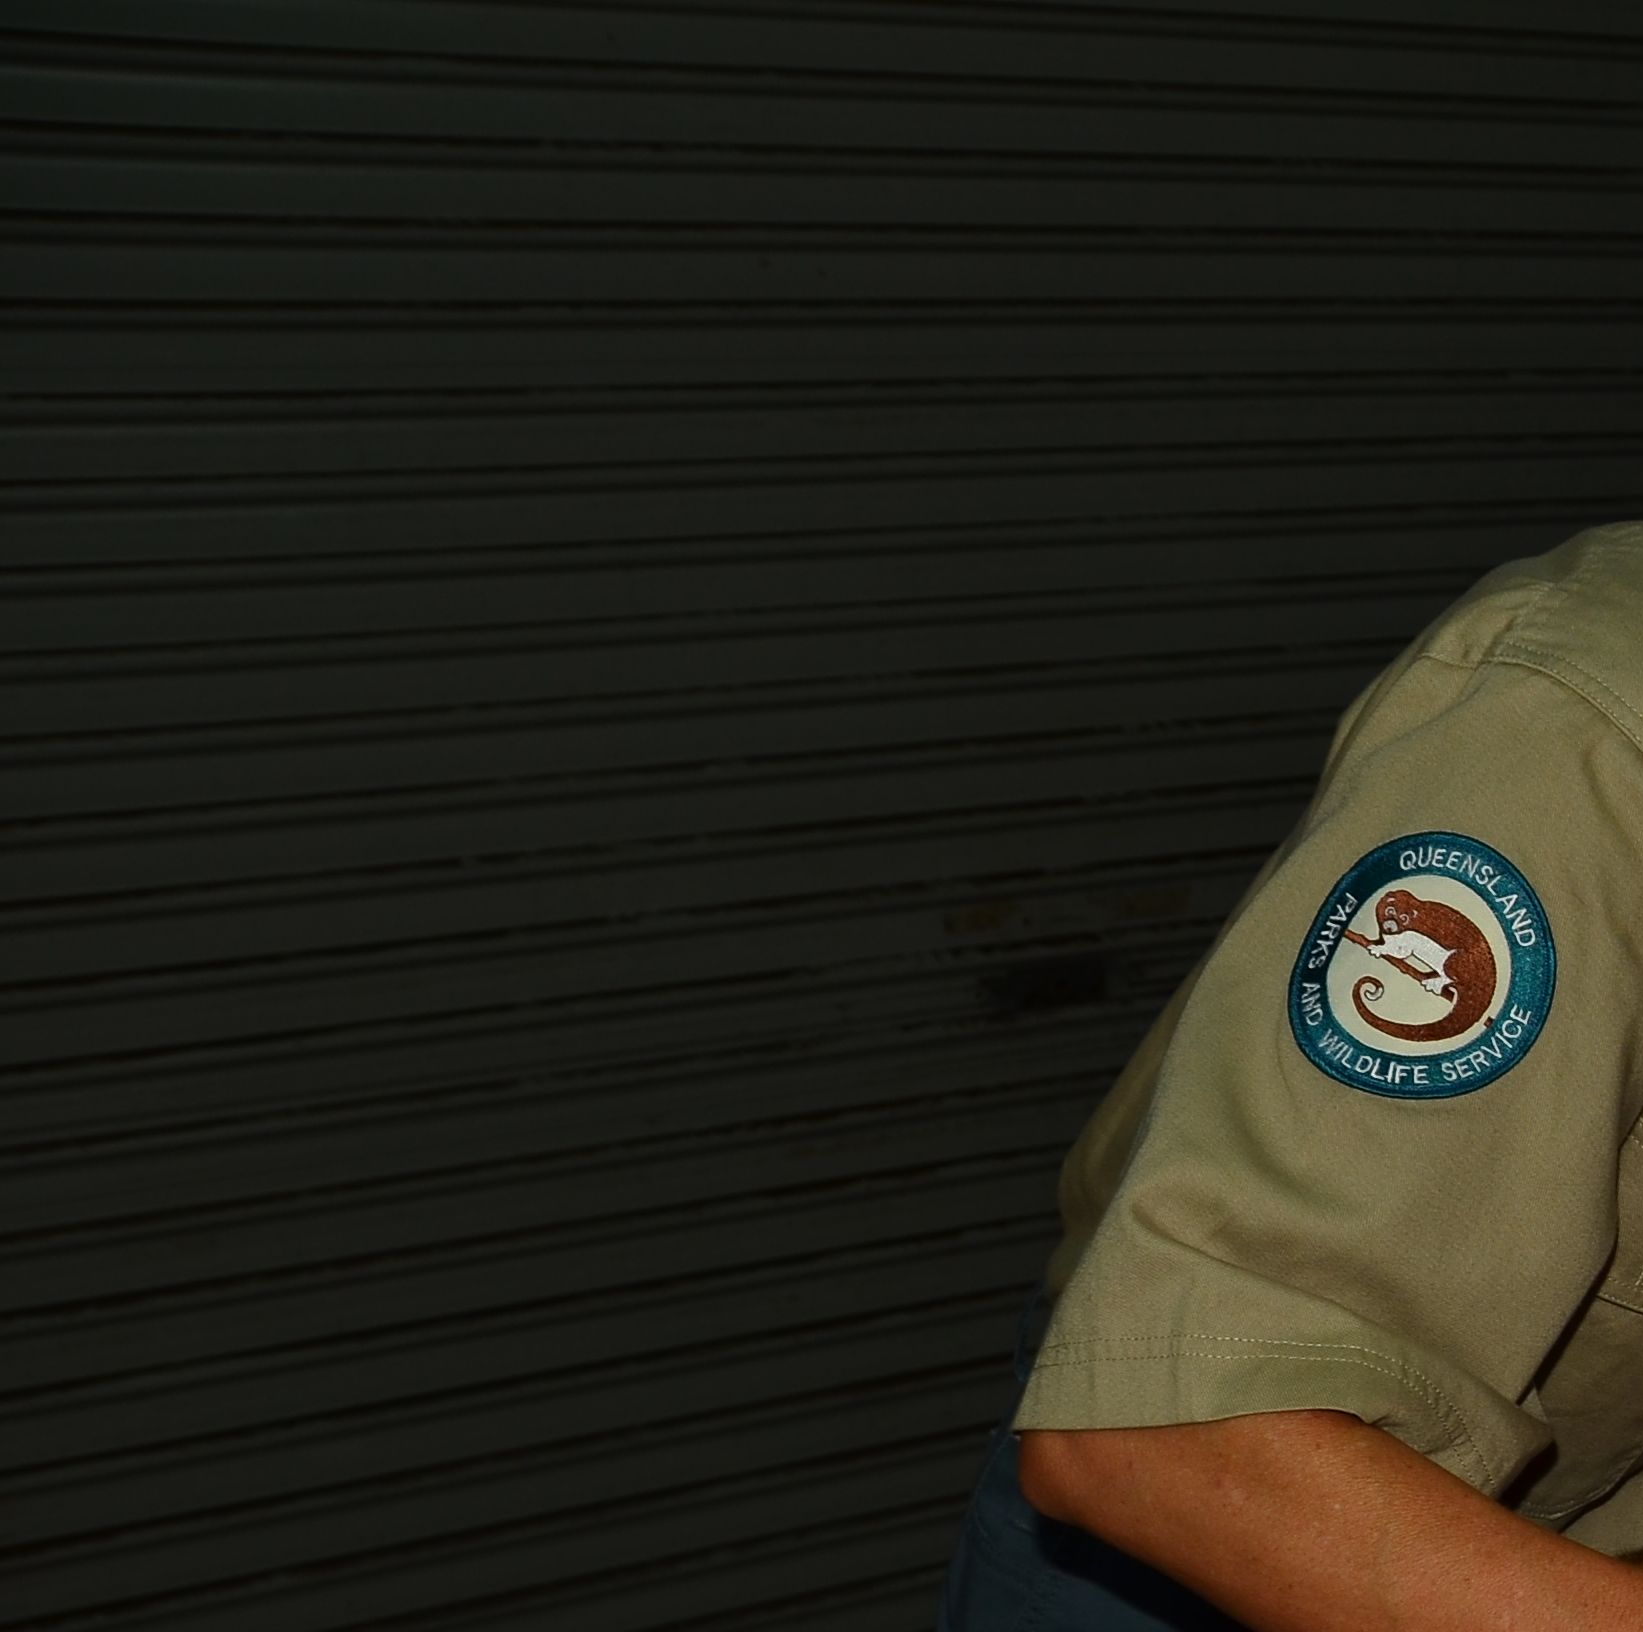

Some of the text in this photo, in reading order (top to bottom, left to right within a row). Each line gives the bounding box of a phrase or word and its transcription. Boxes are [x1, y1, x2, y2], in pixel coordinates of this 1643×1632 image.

[1400, 845, 1536, 948] QUEENSLAND
[1302, 891, 1532, 1086] PARKS AND WILDLIFE SERVICE
